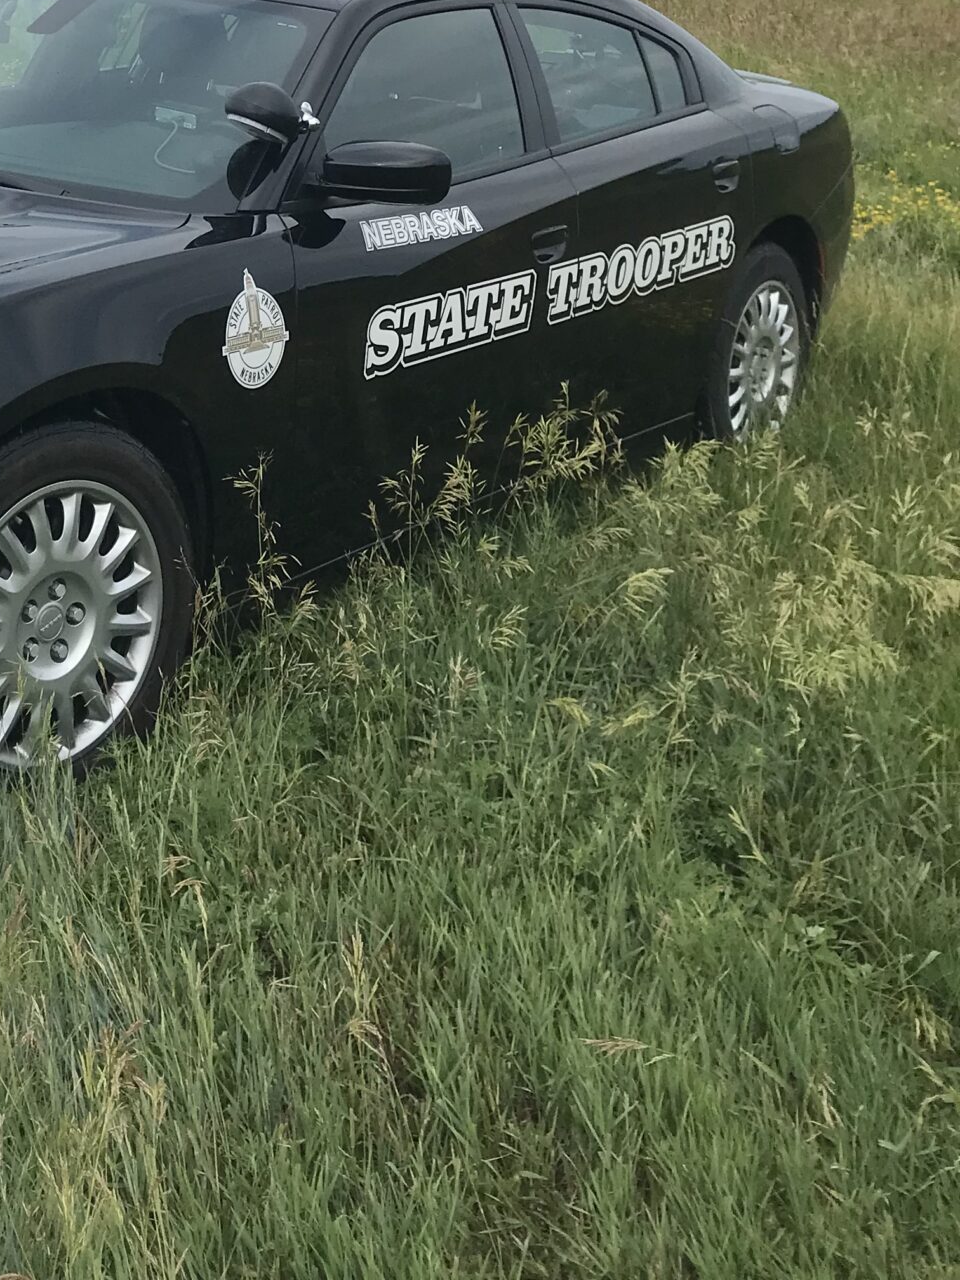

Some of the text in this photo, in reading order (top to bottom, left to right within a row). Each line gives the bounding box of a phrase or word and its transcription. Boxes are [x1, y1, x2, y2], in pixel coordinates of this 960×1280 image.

[359, 205, 483, 252] NEBRASKA
[229, 294, 282, 329] STATE PATROL
[363, 215, 736, 380] STATE TROOPER
[240, 361, 274, 383] NEBRASKA
